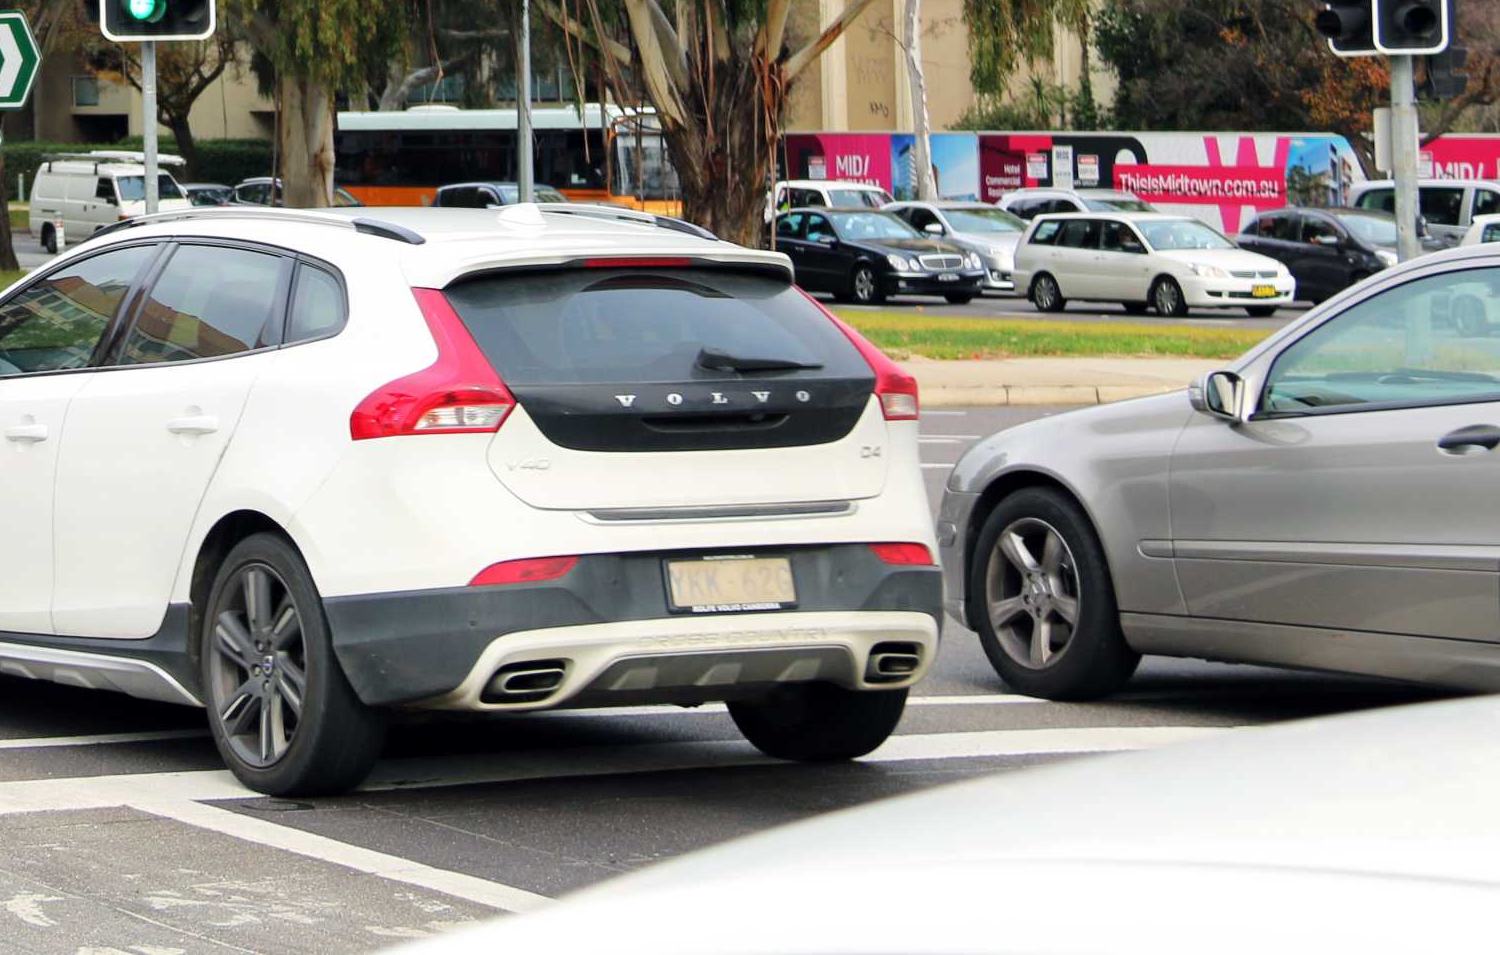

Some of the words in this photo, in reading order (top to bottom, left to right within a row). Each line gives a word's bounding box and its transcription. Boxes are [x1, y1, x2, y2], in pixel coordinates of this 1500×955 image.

[1119, 173, 1279, 199] ThisIsMidtown.com.au
[614, 390, 811, 407] VOLVO
[860, 445, 881, 459] D4
